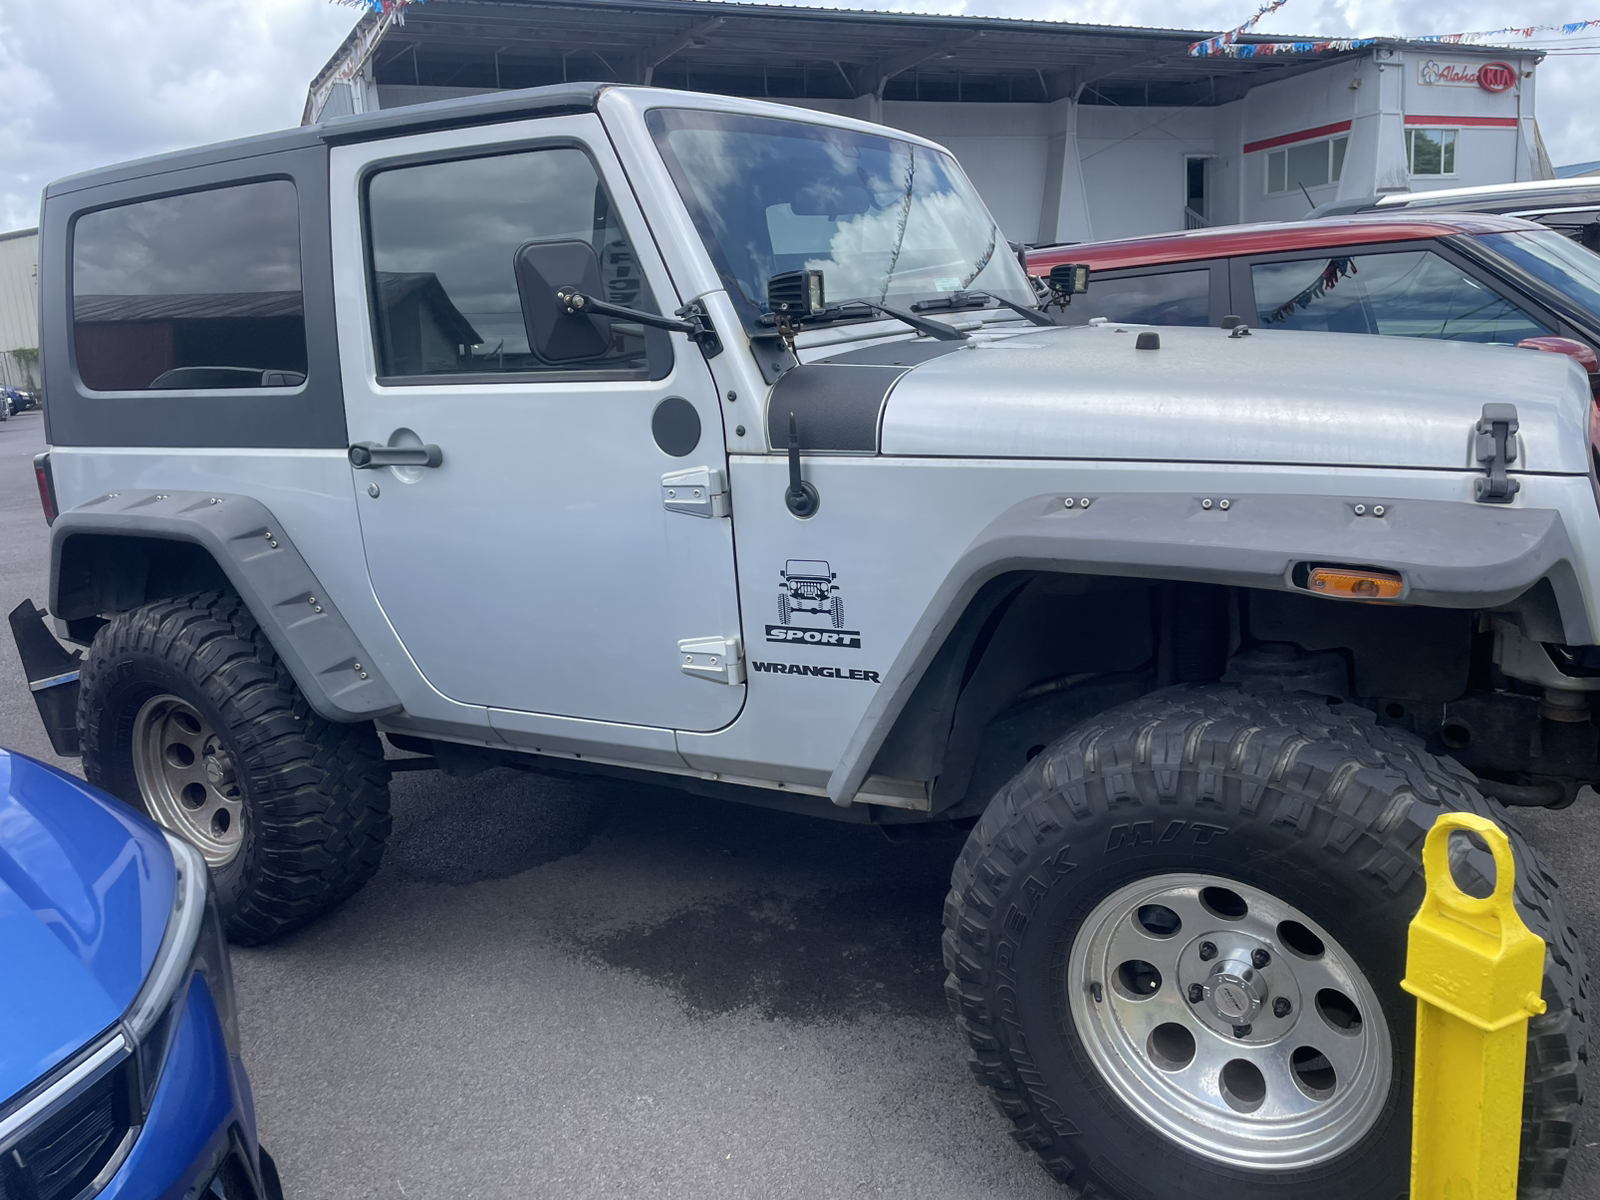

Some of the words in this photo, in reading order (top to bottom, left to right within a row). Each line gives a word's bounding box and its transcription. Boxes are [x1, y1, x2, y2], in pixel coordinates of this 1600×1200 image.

[1437, 65, 1479, 83] Aloha
[1486, 69, 1511, 85] KIA
[767, 628, 860, 646] SPORT
[752, 661, 881, 684] WRANGLER
[995, 844, 1083, 1137] WILDPEAK
[1103, 819, 1230, 856] M/T
